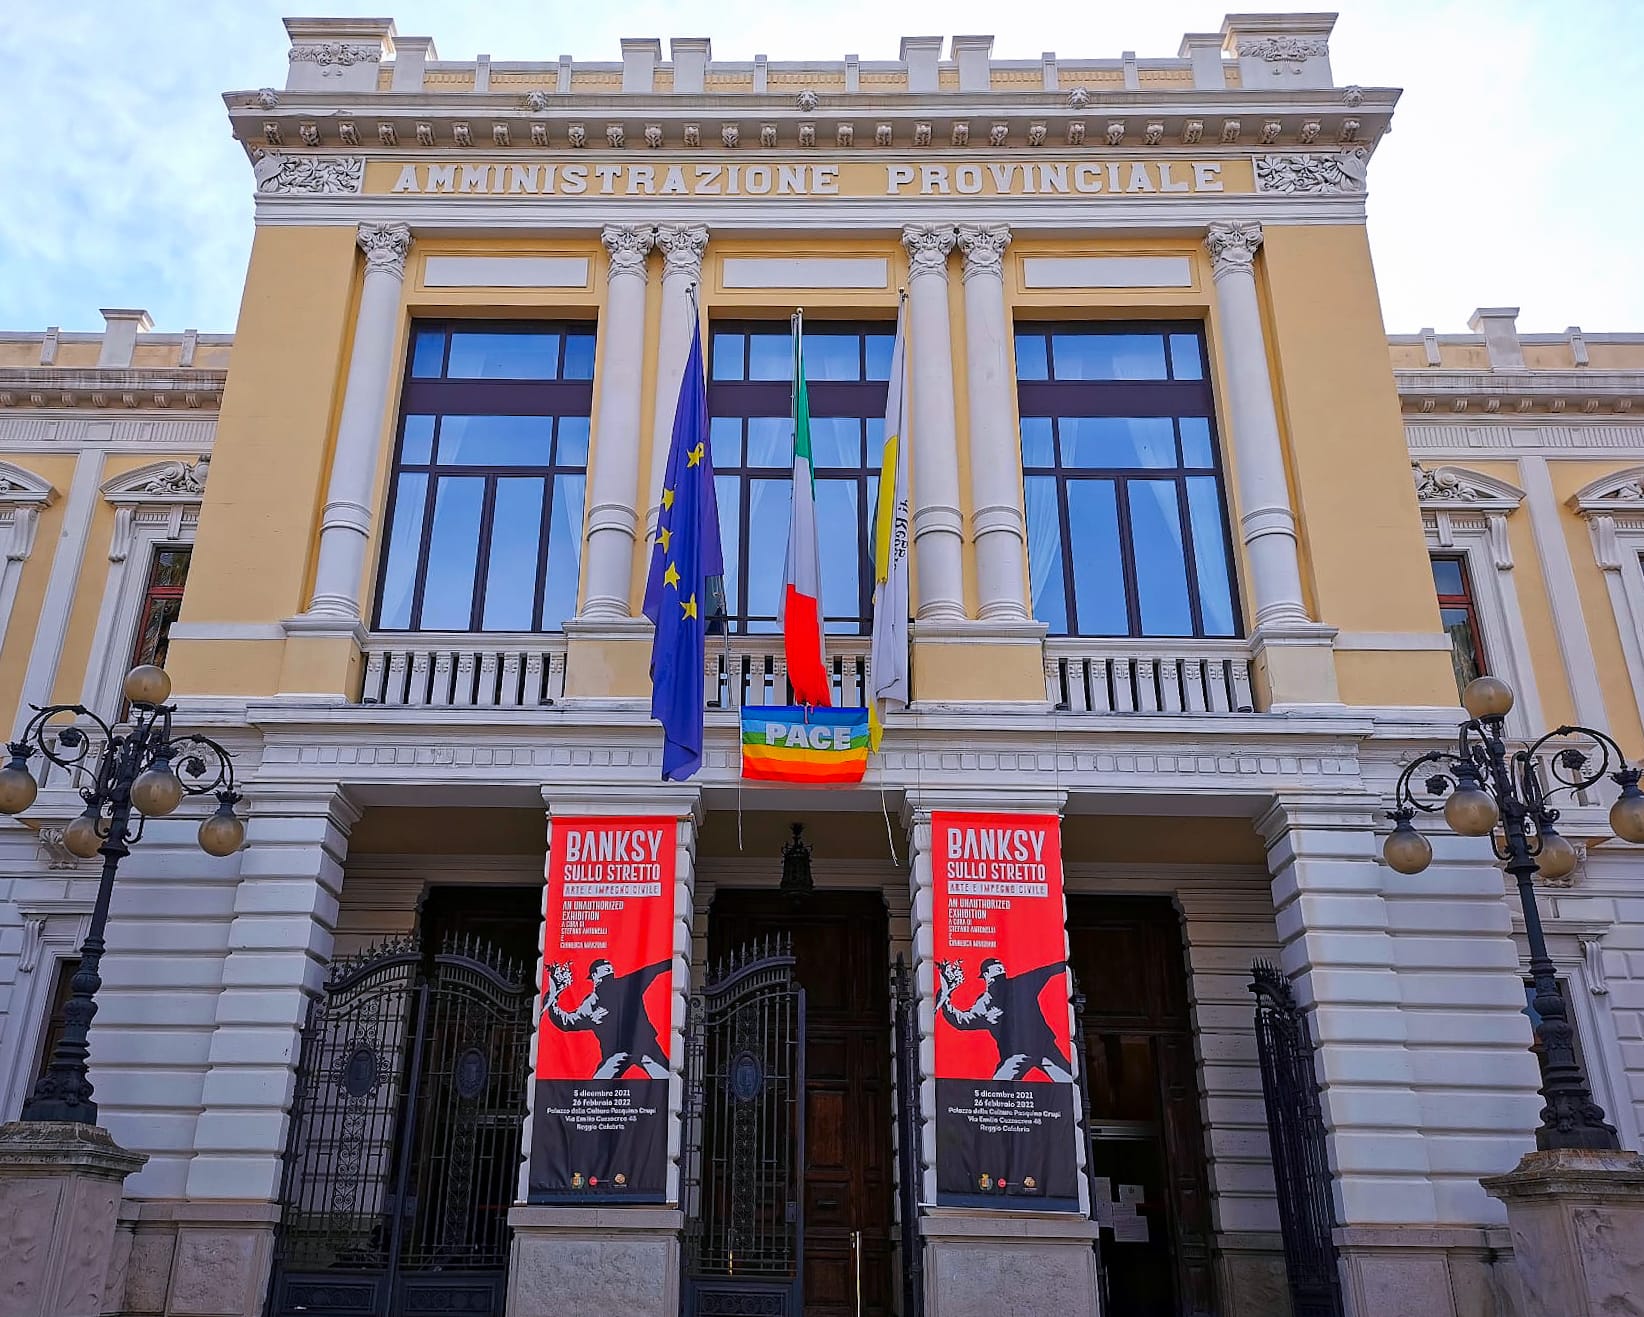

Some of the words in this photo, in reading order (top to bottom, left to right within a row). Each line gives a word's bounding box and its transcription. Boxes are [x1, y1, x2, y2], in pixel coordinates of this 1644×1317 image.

[391, 164, 839, 195] AMMINISTRAZIONE
[885, 163, 1223, 194] PROVINCIALE
[765, 723, 852, 750] PACE
[566, 830, 663, 862] BANKSY
[947, 828, 1046, 862] BANKSY
[564, 864, 603, 881] SULLO
[607, 863, 661, 881] STRETTO
[947, 862, 986, 880] SULLO
[991, 863, 1046, 881] STRETTO
[981, 1090, 1014, 1098] dicembre
[1016, 1091, 1033, 1099] 2021
[984, 1099, 1015, 1107] febbraio
[1016, 1101, 1035, 1109] 2022
